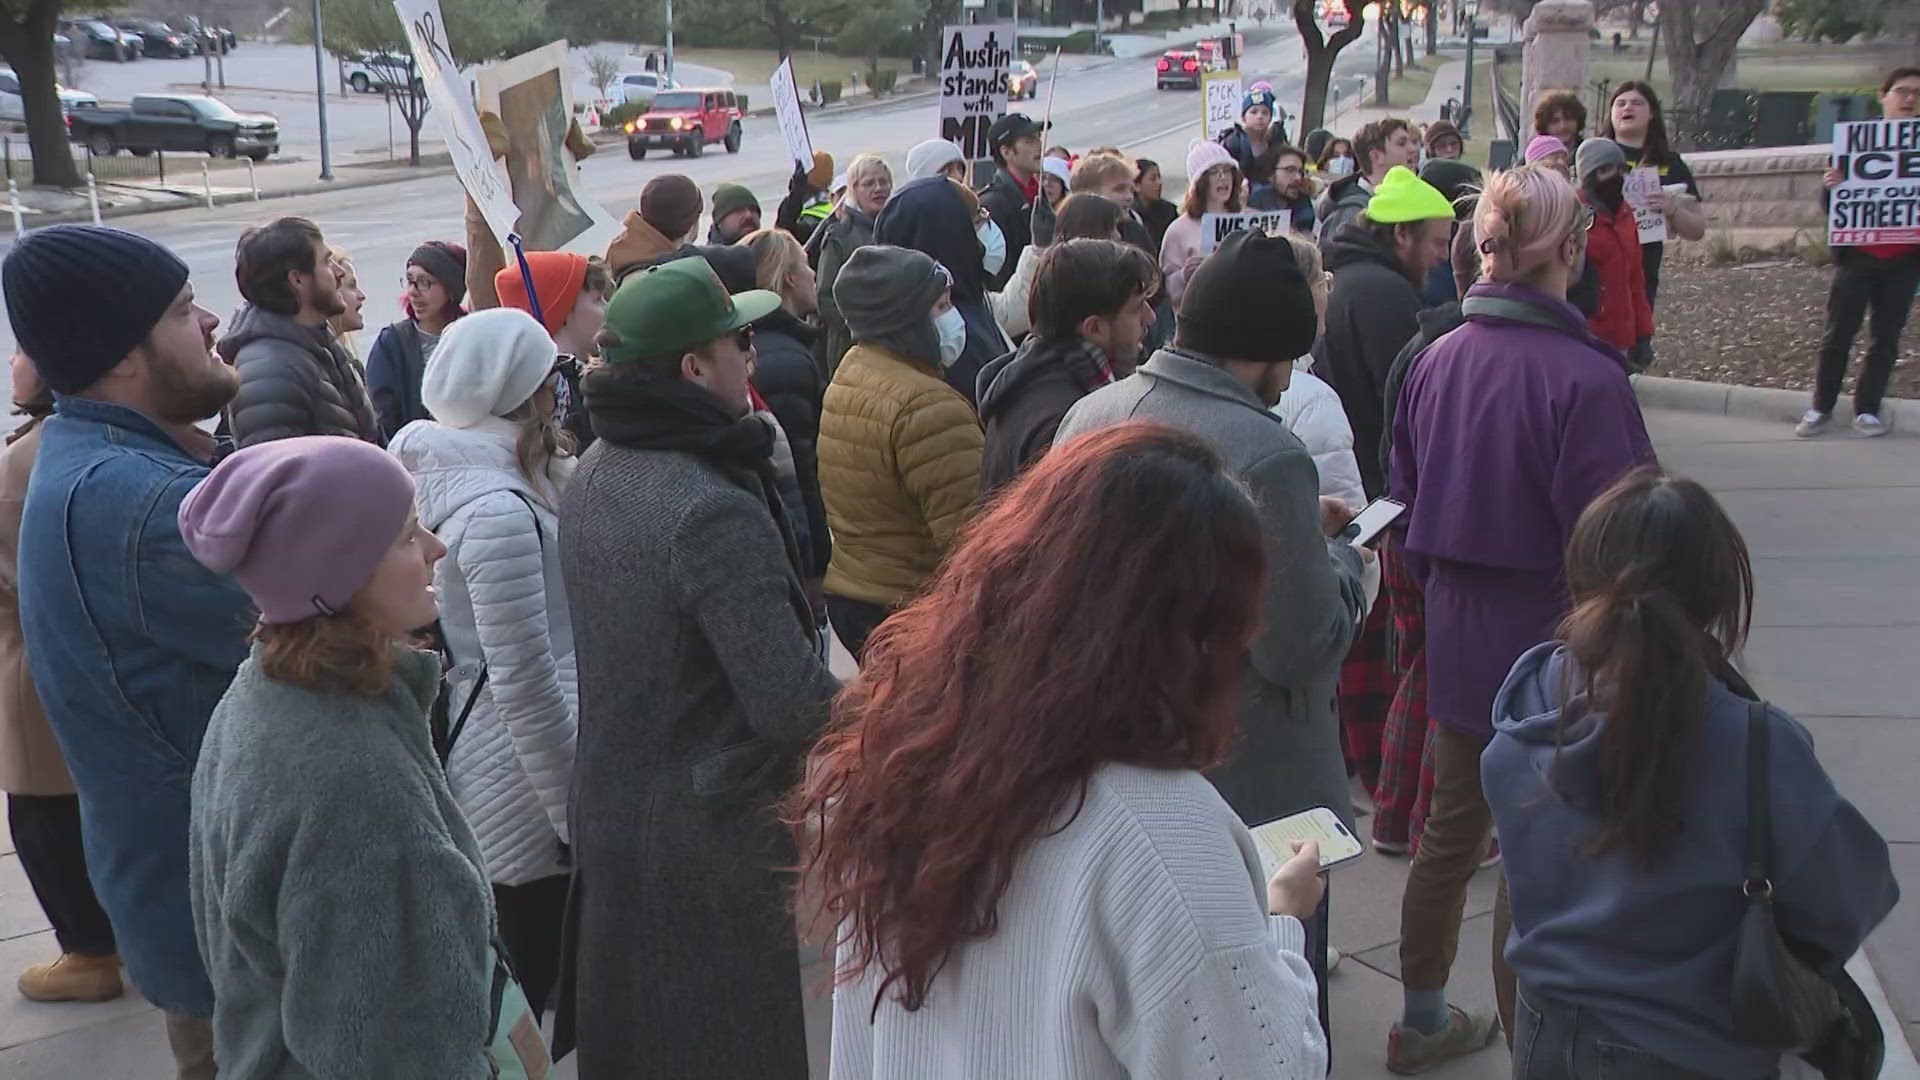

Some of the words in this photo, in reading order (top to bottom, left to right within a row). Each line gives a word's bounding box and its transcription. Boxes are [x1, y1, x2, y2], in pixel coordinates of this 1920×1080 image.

[944, 31, 1010, 69] Austin
[943, 70, 1009, 96] stands
[963, 94, 993, 112] with
[1209, 103, 1233, 122] ICE
[1837, 187, 1881, 199] OFF
[1885, 186, 1920, 198] OU
